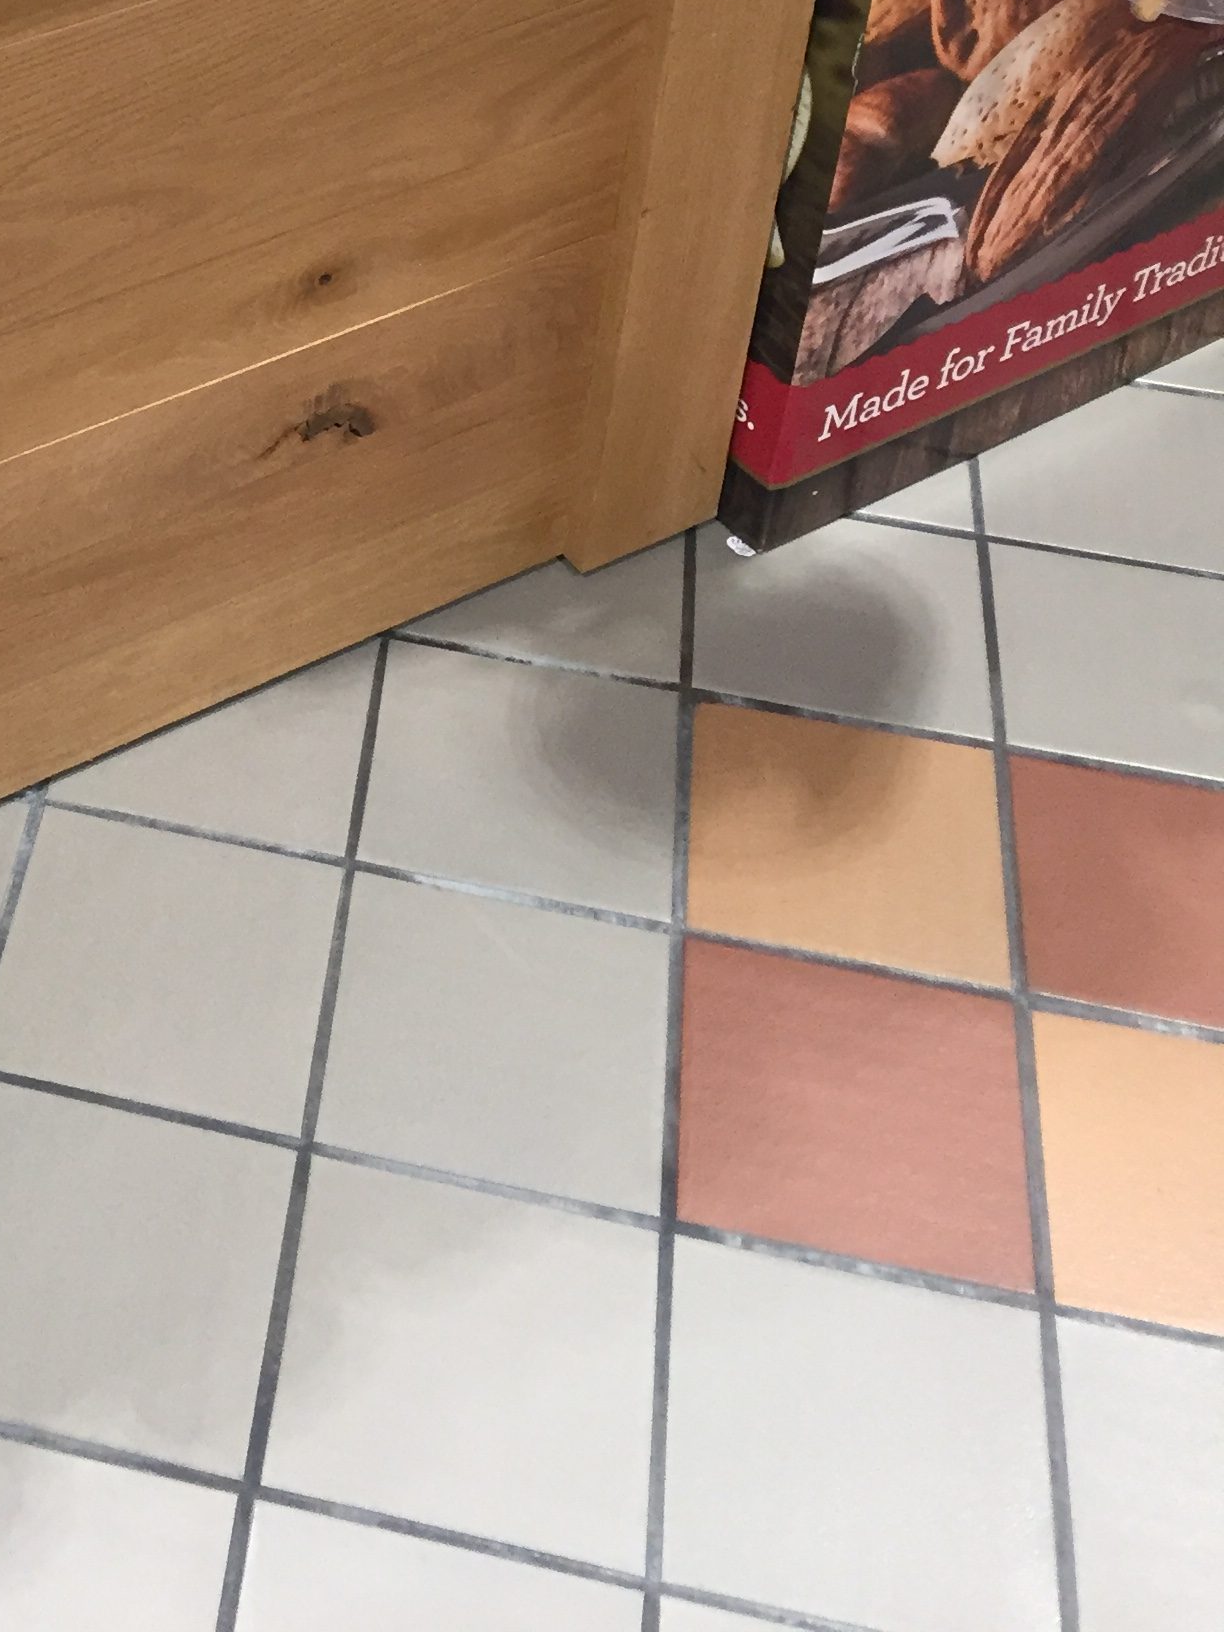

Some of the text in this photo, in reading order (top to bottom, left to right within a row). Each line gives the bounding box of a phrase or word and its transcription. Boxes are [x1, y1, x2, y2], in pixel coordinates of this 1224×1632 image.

[818, 367, 931, 443] Made
[935, 346, 997, 391] for
[999, 283, 1127, 362] Family
